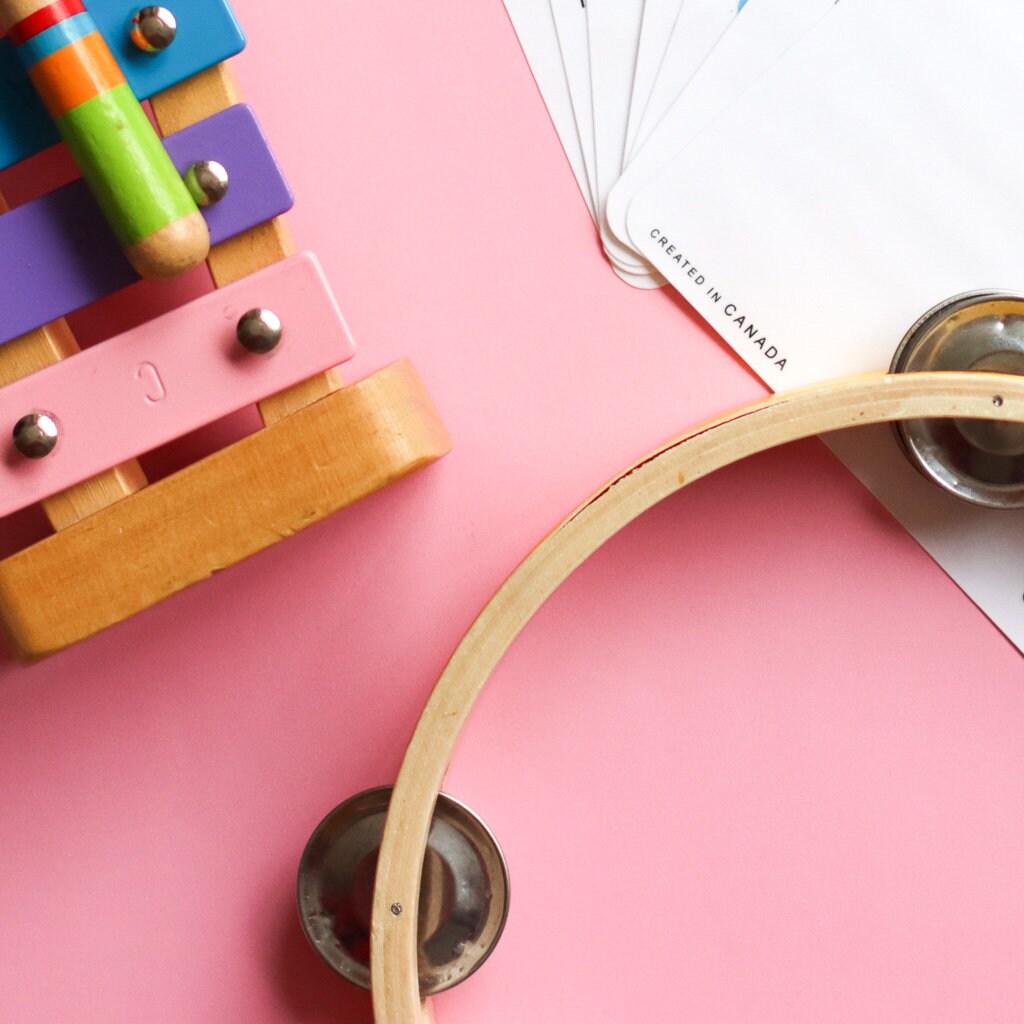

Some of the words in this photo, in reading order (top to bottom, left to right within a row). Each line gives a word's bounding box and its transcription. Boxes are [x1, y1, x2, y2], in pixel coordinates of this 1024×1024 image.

[650, 228, 706, 286] CREATED
[706, 287, 723, 304] IN
[723, 303, 788, 371] CANADA
